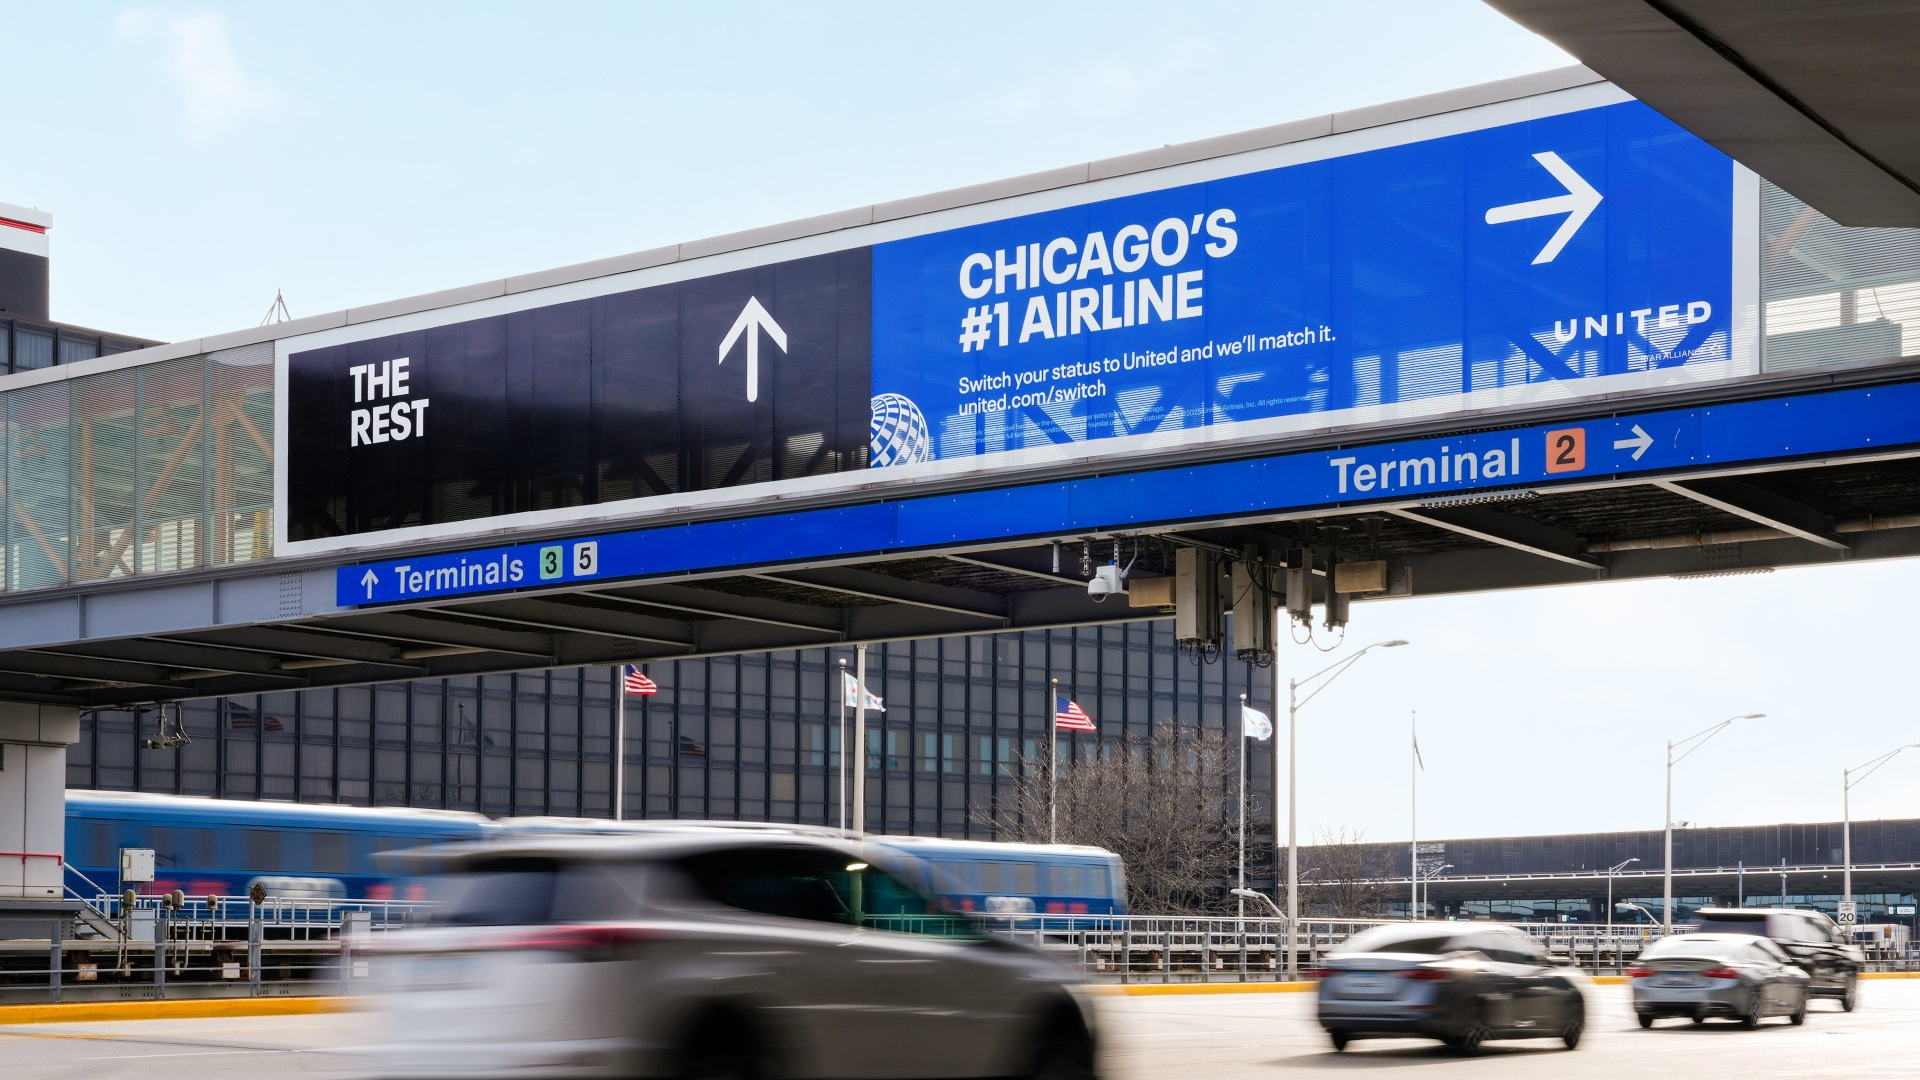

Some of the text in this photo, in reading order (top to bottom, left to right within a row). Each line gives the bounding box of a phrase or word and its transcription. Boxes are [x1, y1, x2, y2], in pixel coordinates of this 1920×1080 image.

[959, 208, 1238, 299] CHICAGO'S
[959, 269, 1203, 353] #1 AIRLINE
[1554, 301, 1712, 342] UNITED
[349, 357, 410, 403] THE
[959, 324, 1336, 395] Switch your status to United and we'll match it.
[1640, 353, 1663, 363] STAR
[959, 379, 1106, 416] united.com/switch
[351, 398, 430, 447] REST
[1330, 435, 1576, 494] Terminal 2
[395, 546, 592, 594] Terminals 3 5
[1840, 913, 1854, 921] 20
